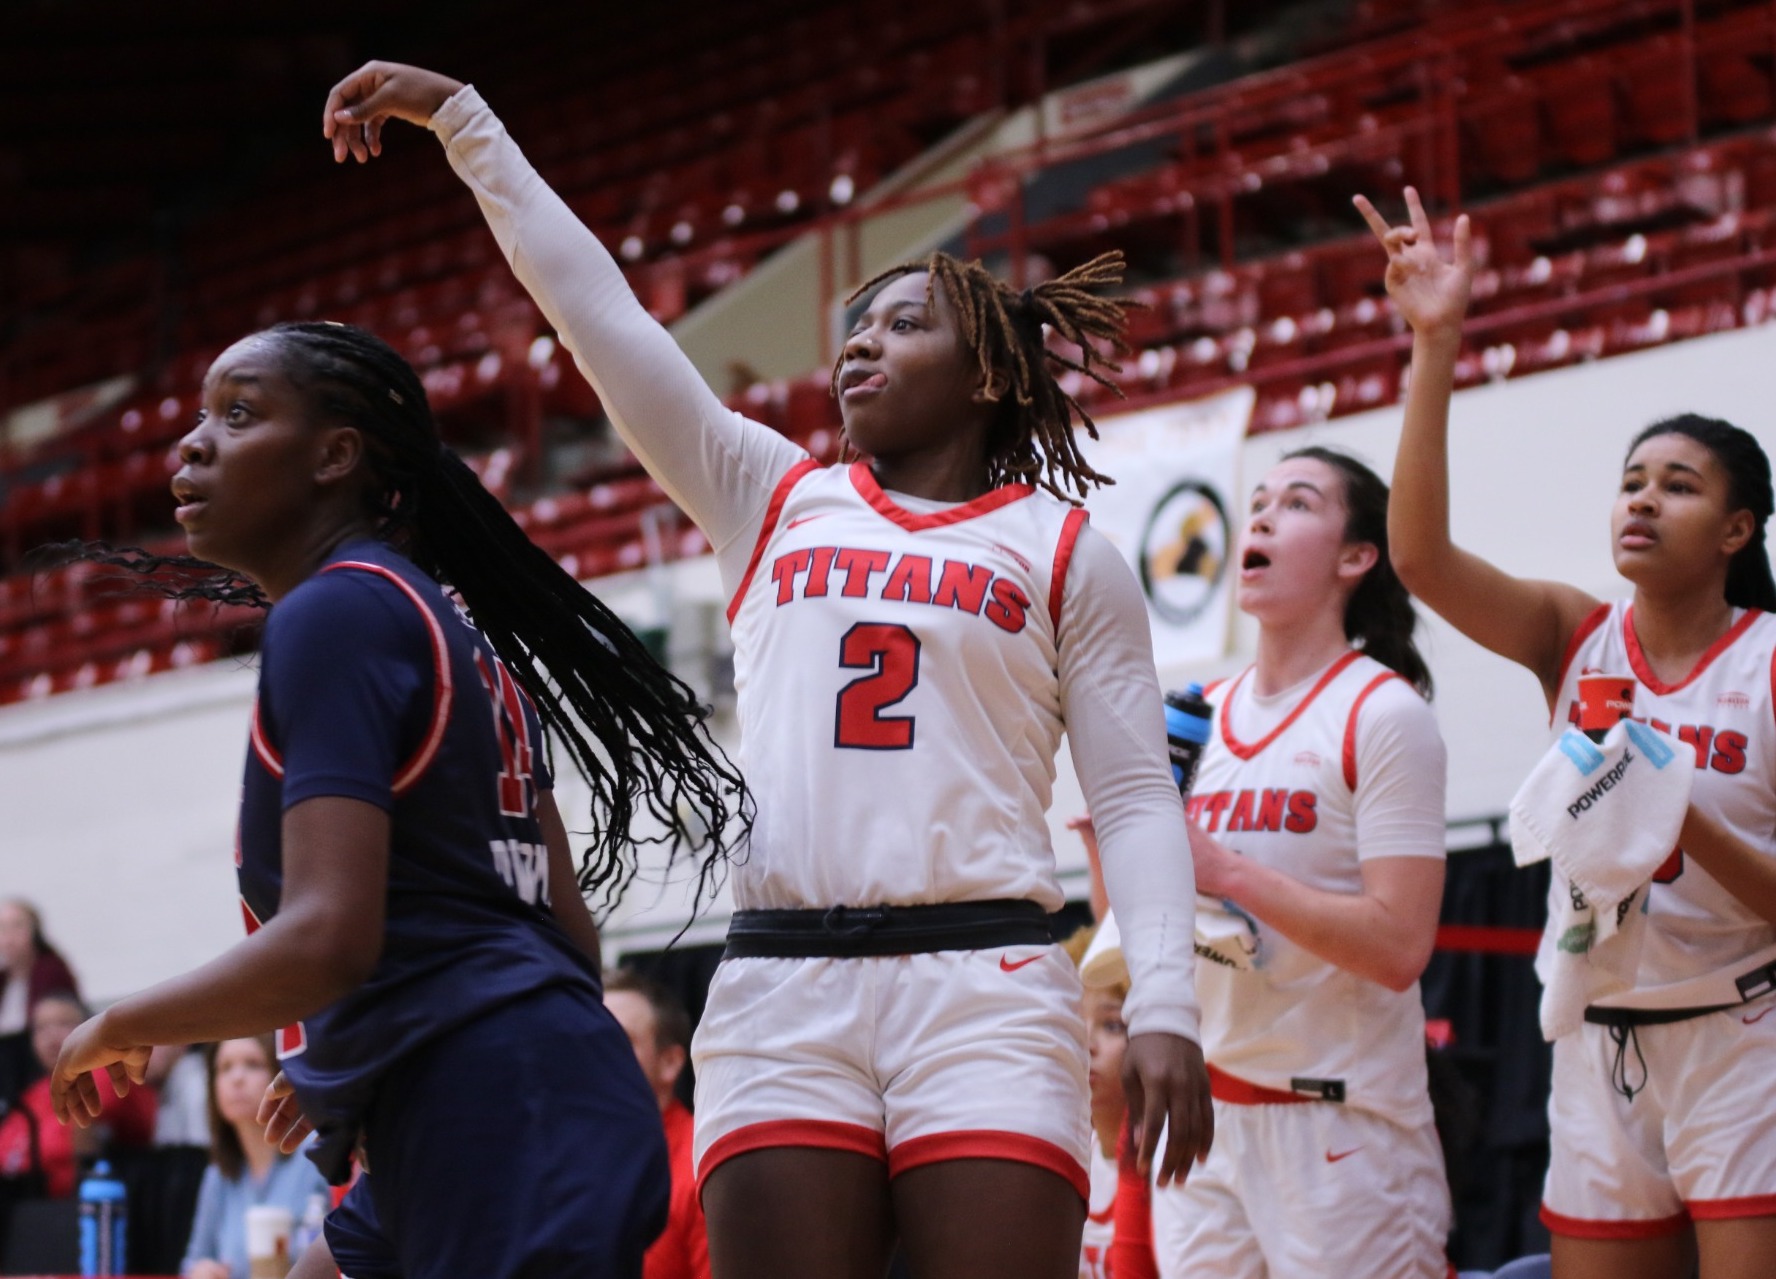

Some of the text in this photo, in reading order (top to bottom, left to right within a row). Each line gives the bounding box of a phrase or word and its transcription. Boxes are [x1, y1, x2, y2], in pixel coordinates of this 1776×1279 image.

[771, 546, 1031, 634] TITANS
[834, 621, 921, 750] 2
[1186, 788, 1317, 834] ITANS
